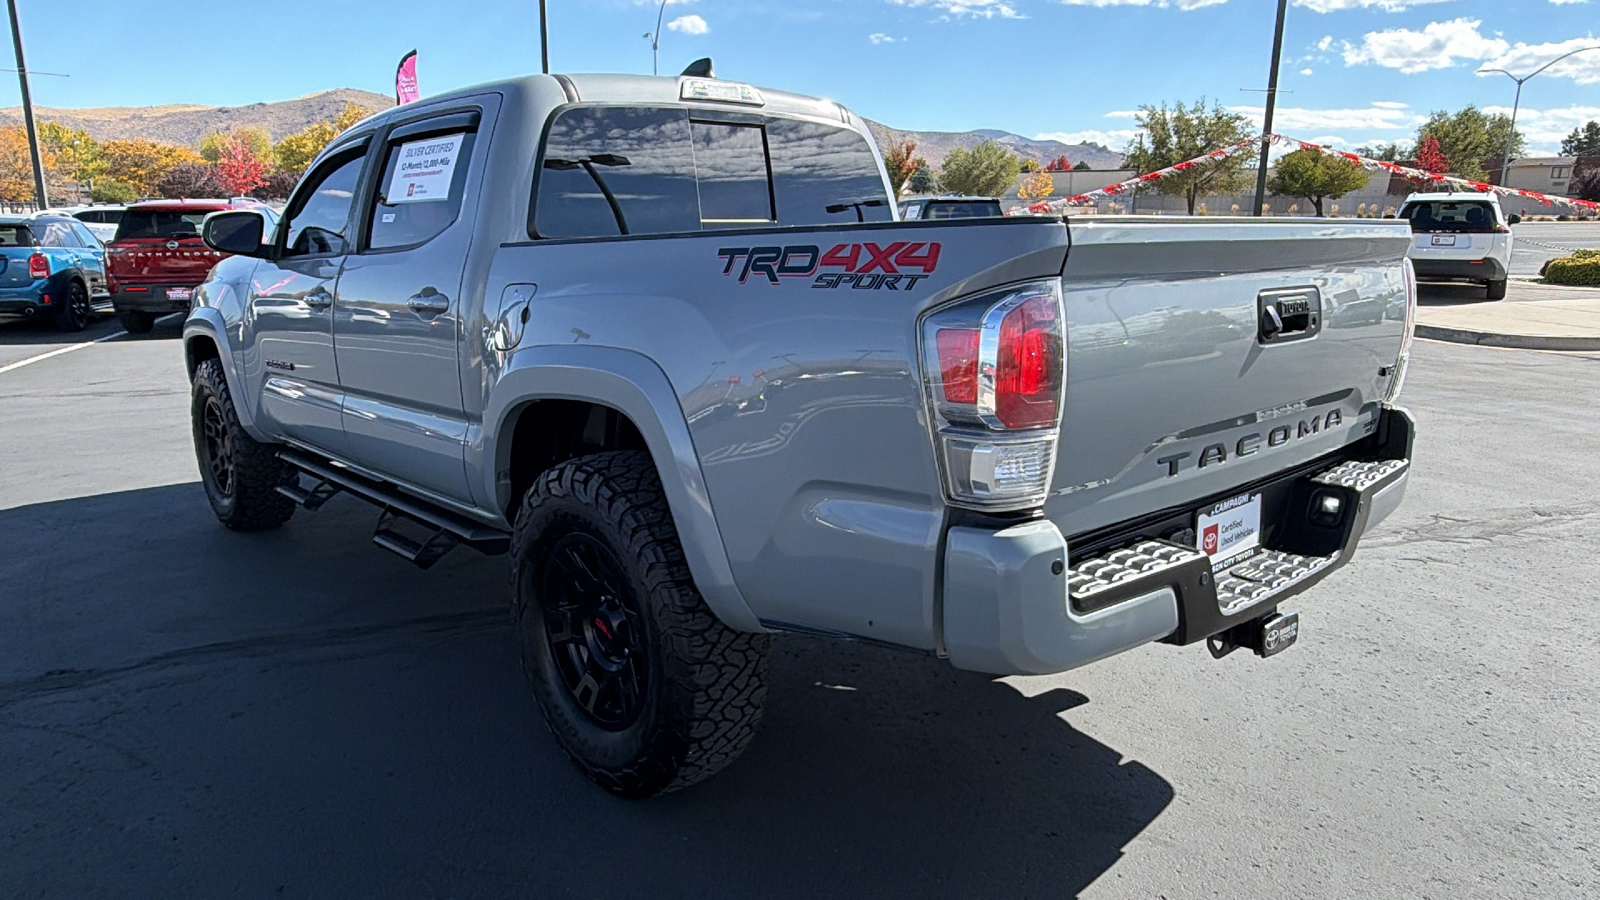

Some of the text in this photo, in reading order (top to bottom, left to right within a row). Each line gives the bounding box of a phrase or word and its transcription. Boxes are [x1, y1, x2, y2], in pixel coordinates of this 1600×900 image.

[405, 142, 454, 158] SILVER CERTIFIED
[717, 245, 821, 285] TRD
[811, 273, 929, 291] SPORT
[1283, 301, 1310, 314] TOYOTA
[1157, 408, 1343, 478] TACOMA
[1214, 494, 1250, 513] CAMPAGNI
[1221, 519, 1243, 533] Certified
[1221, 526, 1254, 547] Used Vehicles
[1223, 557, 1235, 570] CITY
[1236, 549, 1254, 563] TOYOTA
